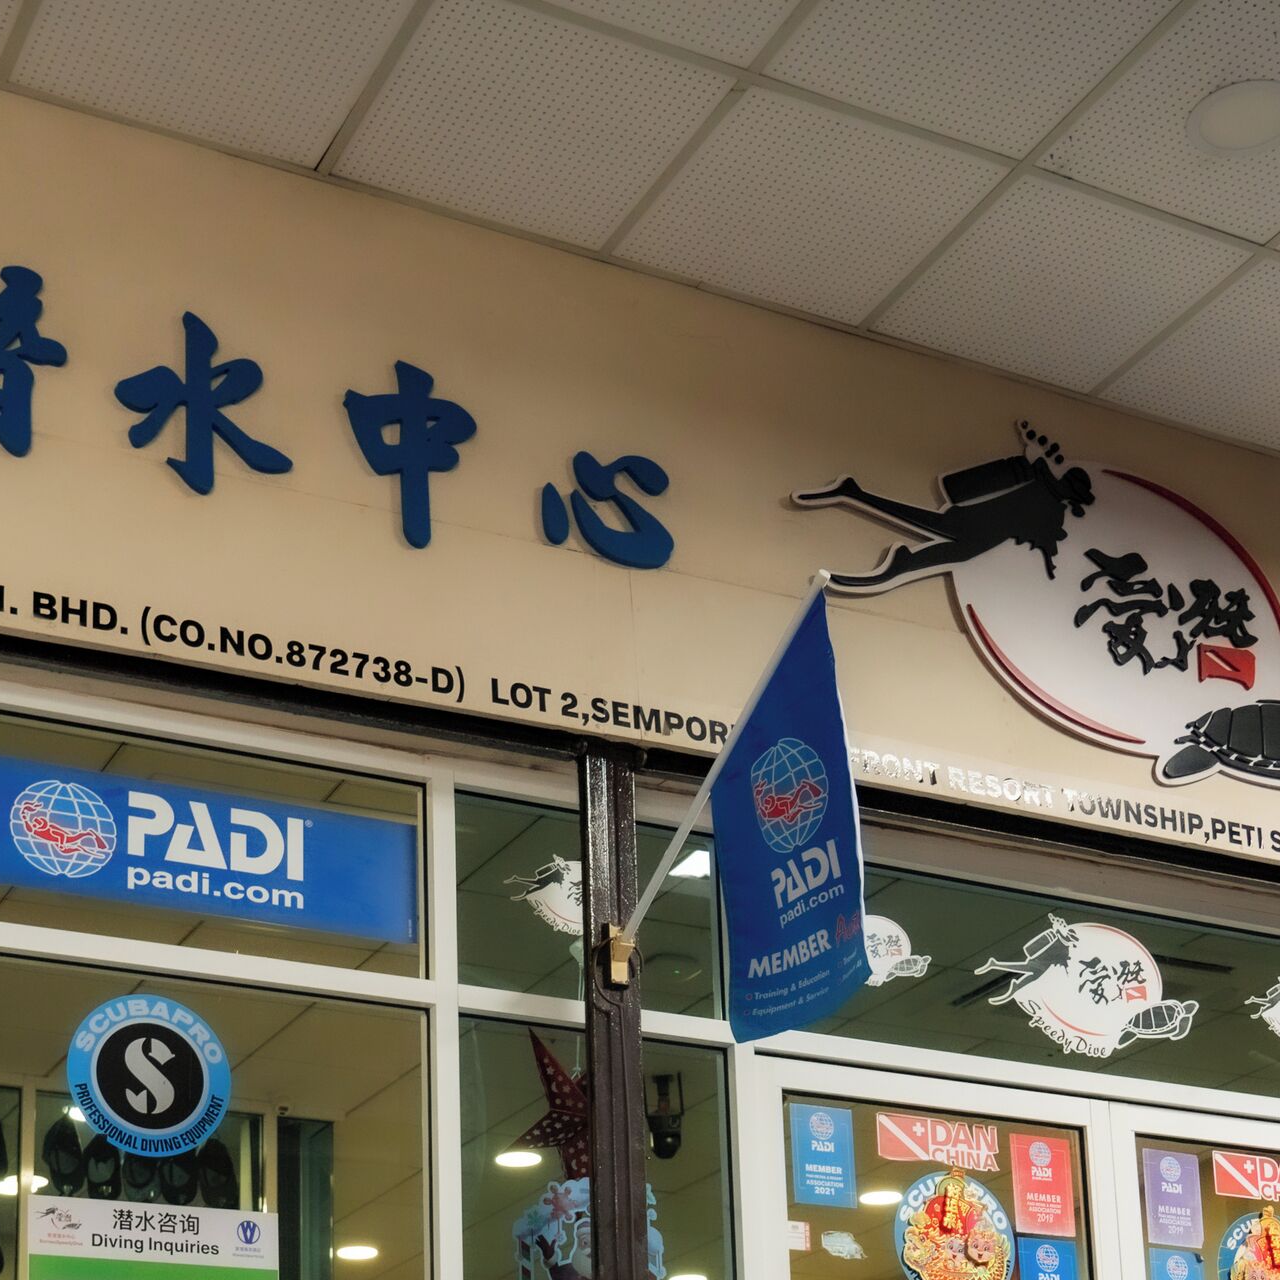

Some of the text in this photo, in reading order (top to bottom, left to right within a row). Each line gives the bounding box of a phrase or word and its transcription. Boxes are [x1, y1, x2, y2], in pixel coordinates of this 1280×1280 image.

[32, 592, 129, 635] BHD.
[140, 607, 466, 702] (CO.NO.872738-D)
[490, 677, 551, 711] LOT
[561, 692, 739, 745] 2,SEMPOR
[949, 764, 1055, 808] RESORT
[127, 790, 305, 881] PADI
[126, 866, 304, 910] padi.com
[770, 838, 841, 908] PADI
[780, 883, 845, 929] padi.com
[748, 928, 832, 979] MEMBER
[76, 998, 223, 1064] SCUBAPRO
[1021, 1000, 1108, 1058] Speedy Dive
[75, 1082, 225, 1153] PROFESSIONAL DIVING EQUIPMENT
[811, 1140, 835, 1152] PADI
[929, 1119, 999, 1154] DAN
[805, 1163, 843, 1174] MEMBER
[930, 1147, 1000, 1173] CHINA
[1031, 1166, 1052, 1177] PADI
[814, 1186, 835, 1195] 2021
[1026, 1192, 1061, 1203] MEMBER
[1161, 1182, 1183, 1194] PADI
[112, 1208, 201, 1236] 潜水咨询
[1158, 1205, 1191, 1216] MEMBER
[91, 1234, 145, 1253] Diving
[148, 1237, 220, 1256] Inquiries
